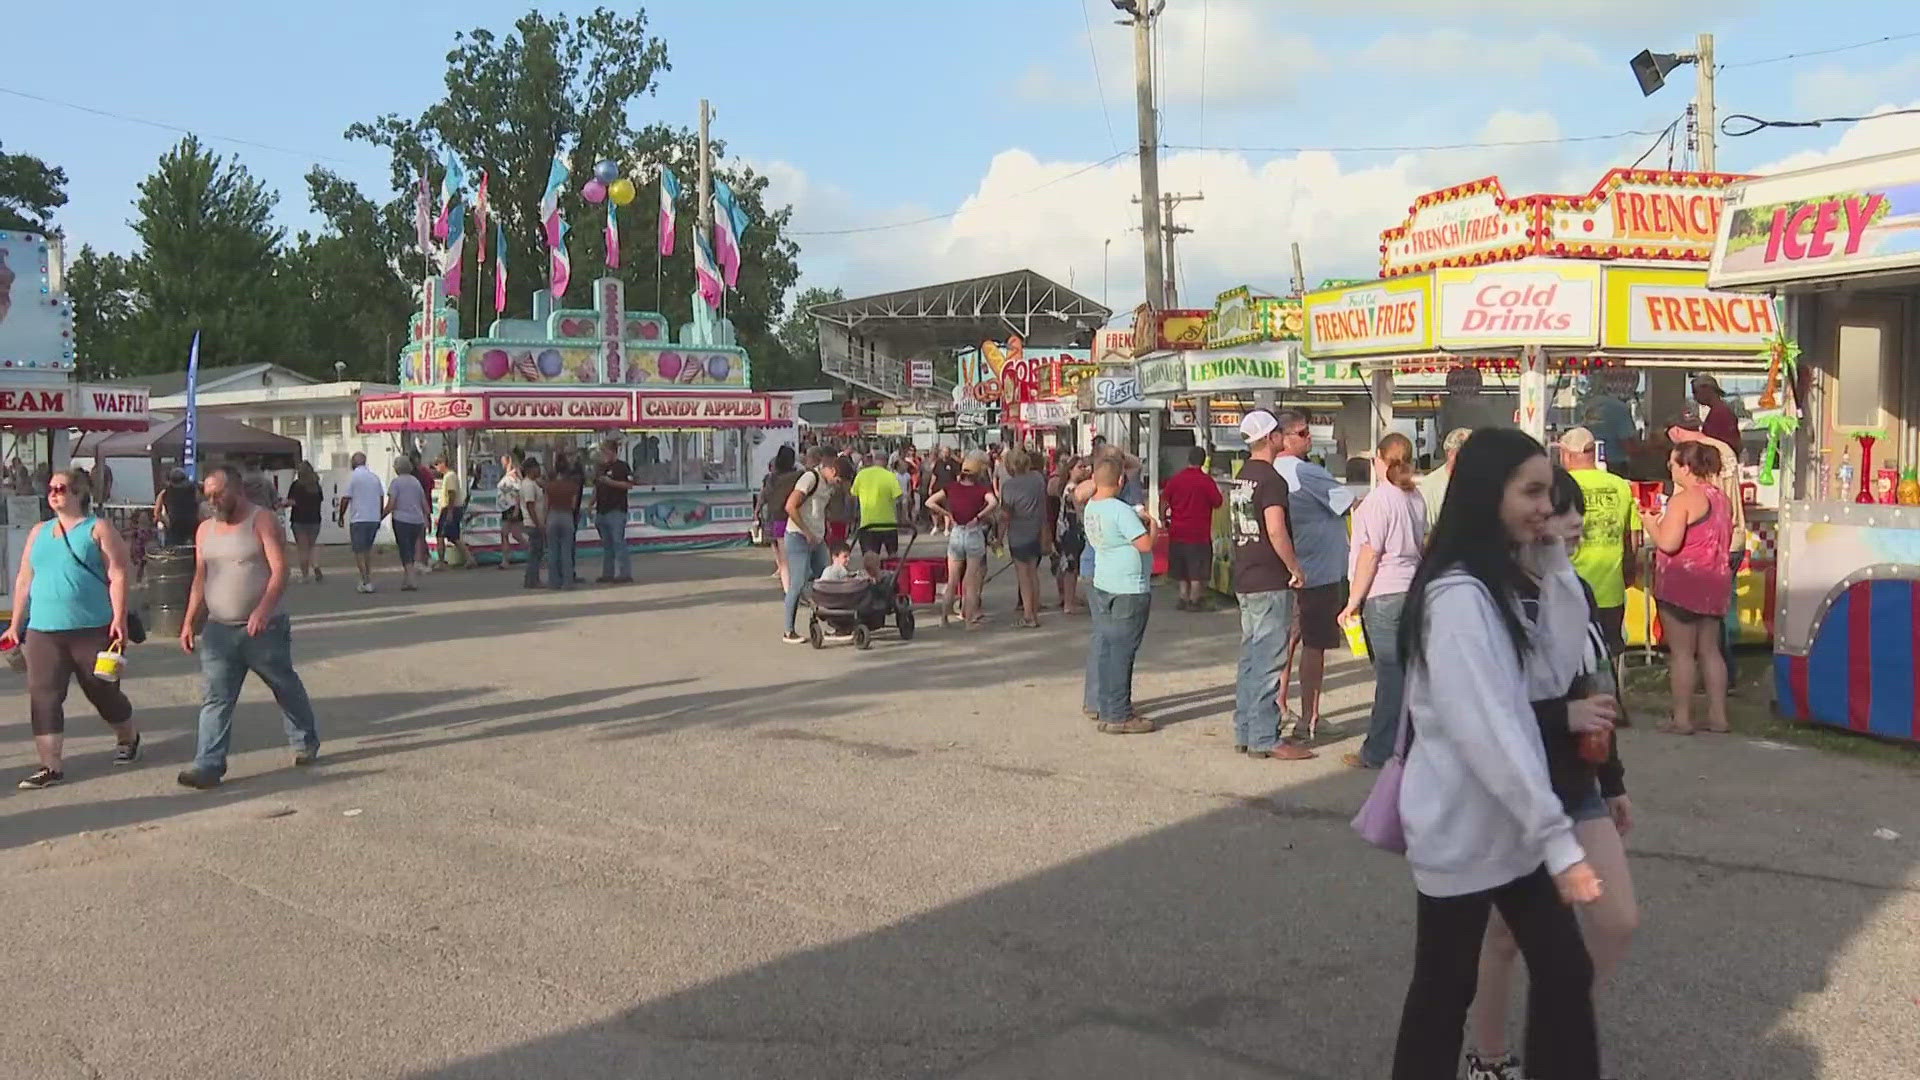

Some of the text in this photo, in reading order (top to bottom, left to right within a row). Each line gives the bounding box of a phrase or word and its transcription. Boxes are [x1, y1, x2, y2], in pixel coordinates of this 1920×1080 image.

[1412, 214, 1500, 254] FRENCH FRIES
[1764, 192, 1885, 263] ICEY
[1475, 283, 1557, 307] Cold
[1315, 300, 1416, 343] FRENCH FRIES
[1461, 309, 1572, 331] Drinks
[1646, 296, 1773, 333] FRENCH
[1191, 358, 1285, 381] LEMONADE
[364, 402, 409, 420] POPCORN
[494, 401, 623, 417] COTTON CANDY
[645, 401, 700, 416] CANDY
[704, 401, 762, 416] APPLES
